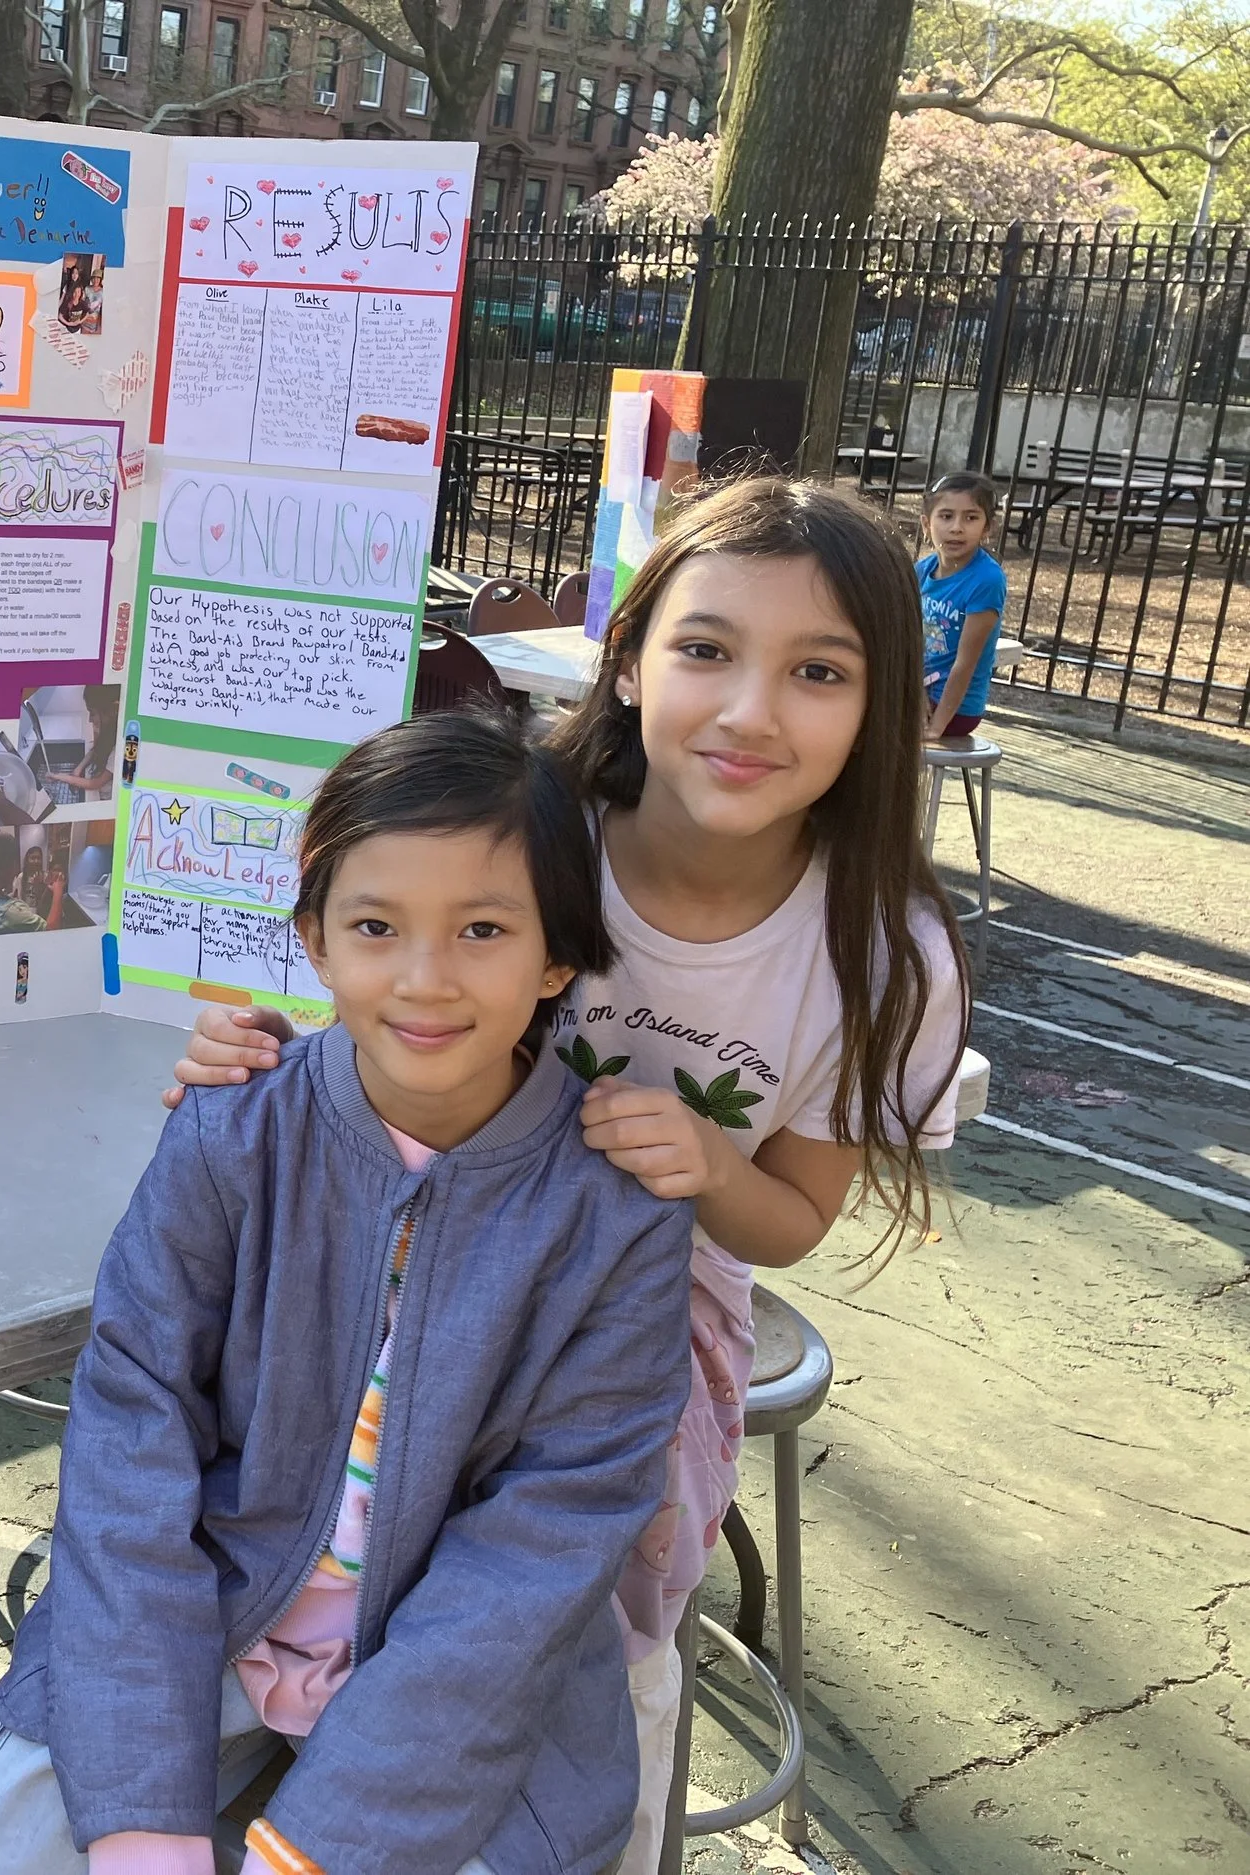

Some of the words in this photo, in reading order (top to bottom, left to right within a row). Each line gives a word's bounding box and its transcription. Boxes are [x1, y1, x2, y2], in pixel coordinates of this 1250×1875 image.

[224, 185, 460, 260] RESULTS
[206, 287, 228, 297] Olive
[295, 293, 328, 307] Blake
[373, 298, 402, 311] Lila
[163, 478, 420, 589] CONCLUSION
[150, 588, 182, 605] Our
[192, 593, 273, 617] Hypothesis
[320, 609, 341, 622] not
[151, 609, 179, 623] Based
[213, 613, 235, 626] the
[248, 618, 290, 633] results
[299, 625, 313, 636] of
[150, 626, 177, 639] The
[189, 629, 243, 647] Band-Aid
[253, 636, 284, 647] Brand
[362, 643, 405, 661] Band-Aid
[151, 642, 164, 653] did
[190, 647, 209, 661] good
[214, 648, 230, 664] job
[240, 649, 290, 670] protecting
[330, 653, 355, 665] skin
[149, 667, 173, 679] The
[226, 675, 272, 688] Band-Aid
[284, 682, 311, 692] brand
[346, 687, 366, 700] the
[204, 660, 223, 671] and
[292, 668, 312, 688] top
[322, 668, 352, 689] pick.
[150, 692, 186, 710] fingers
[196, 699, 243, 717] wrinkly.
[212, 688, 265, 705] Band-Aid,
[269, 692, 295, 703] that
[123, 908, 136, 919] for
[139, 913, 157, 925] your
[161, 917, 189, 930] support
[586, 1003, 616, 1024] on
[625, 1008, 719, 1048] Island
[718, 1040, 780, 1087] Time
